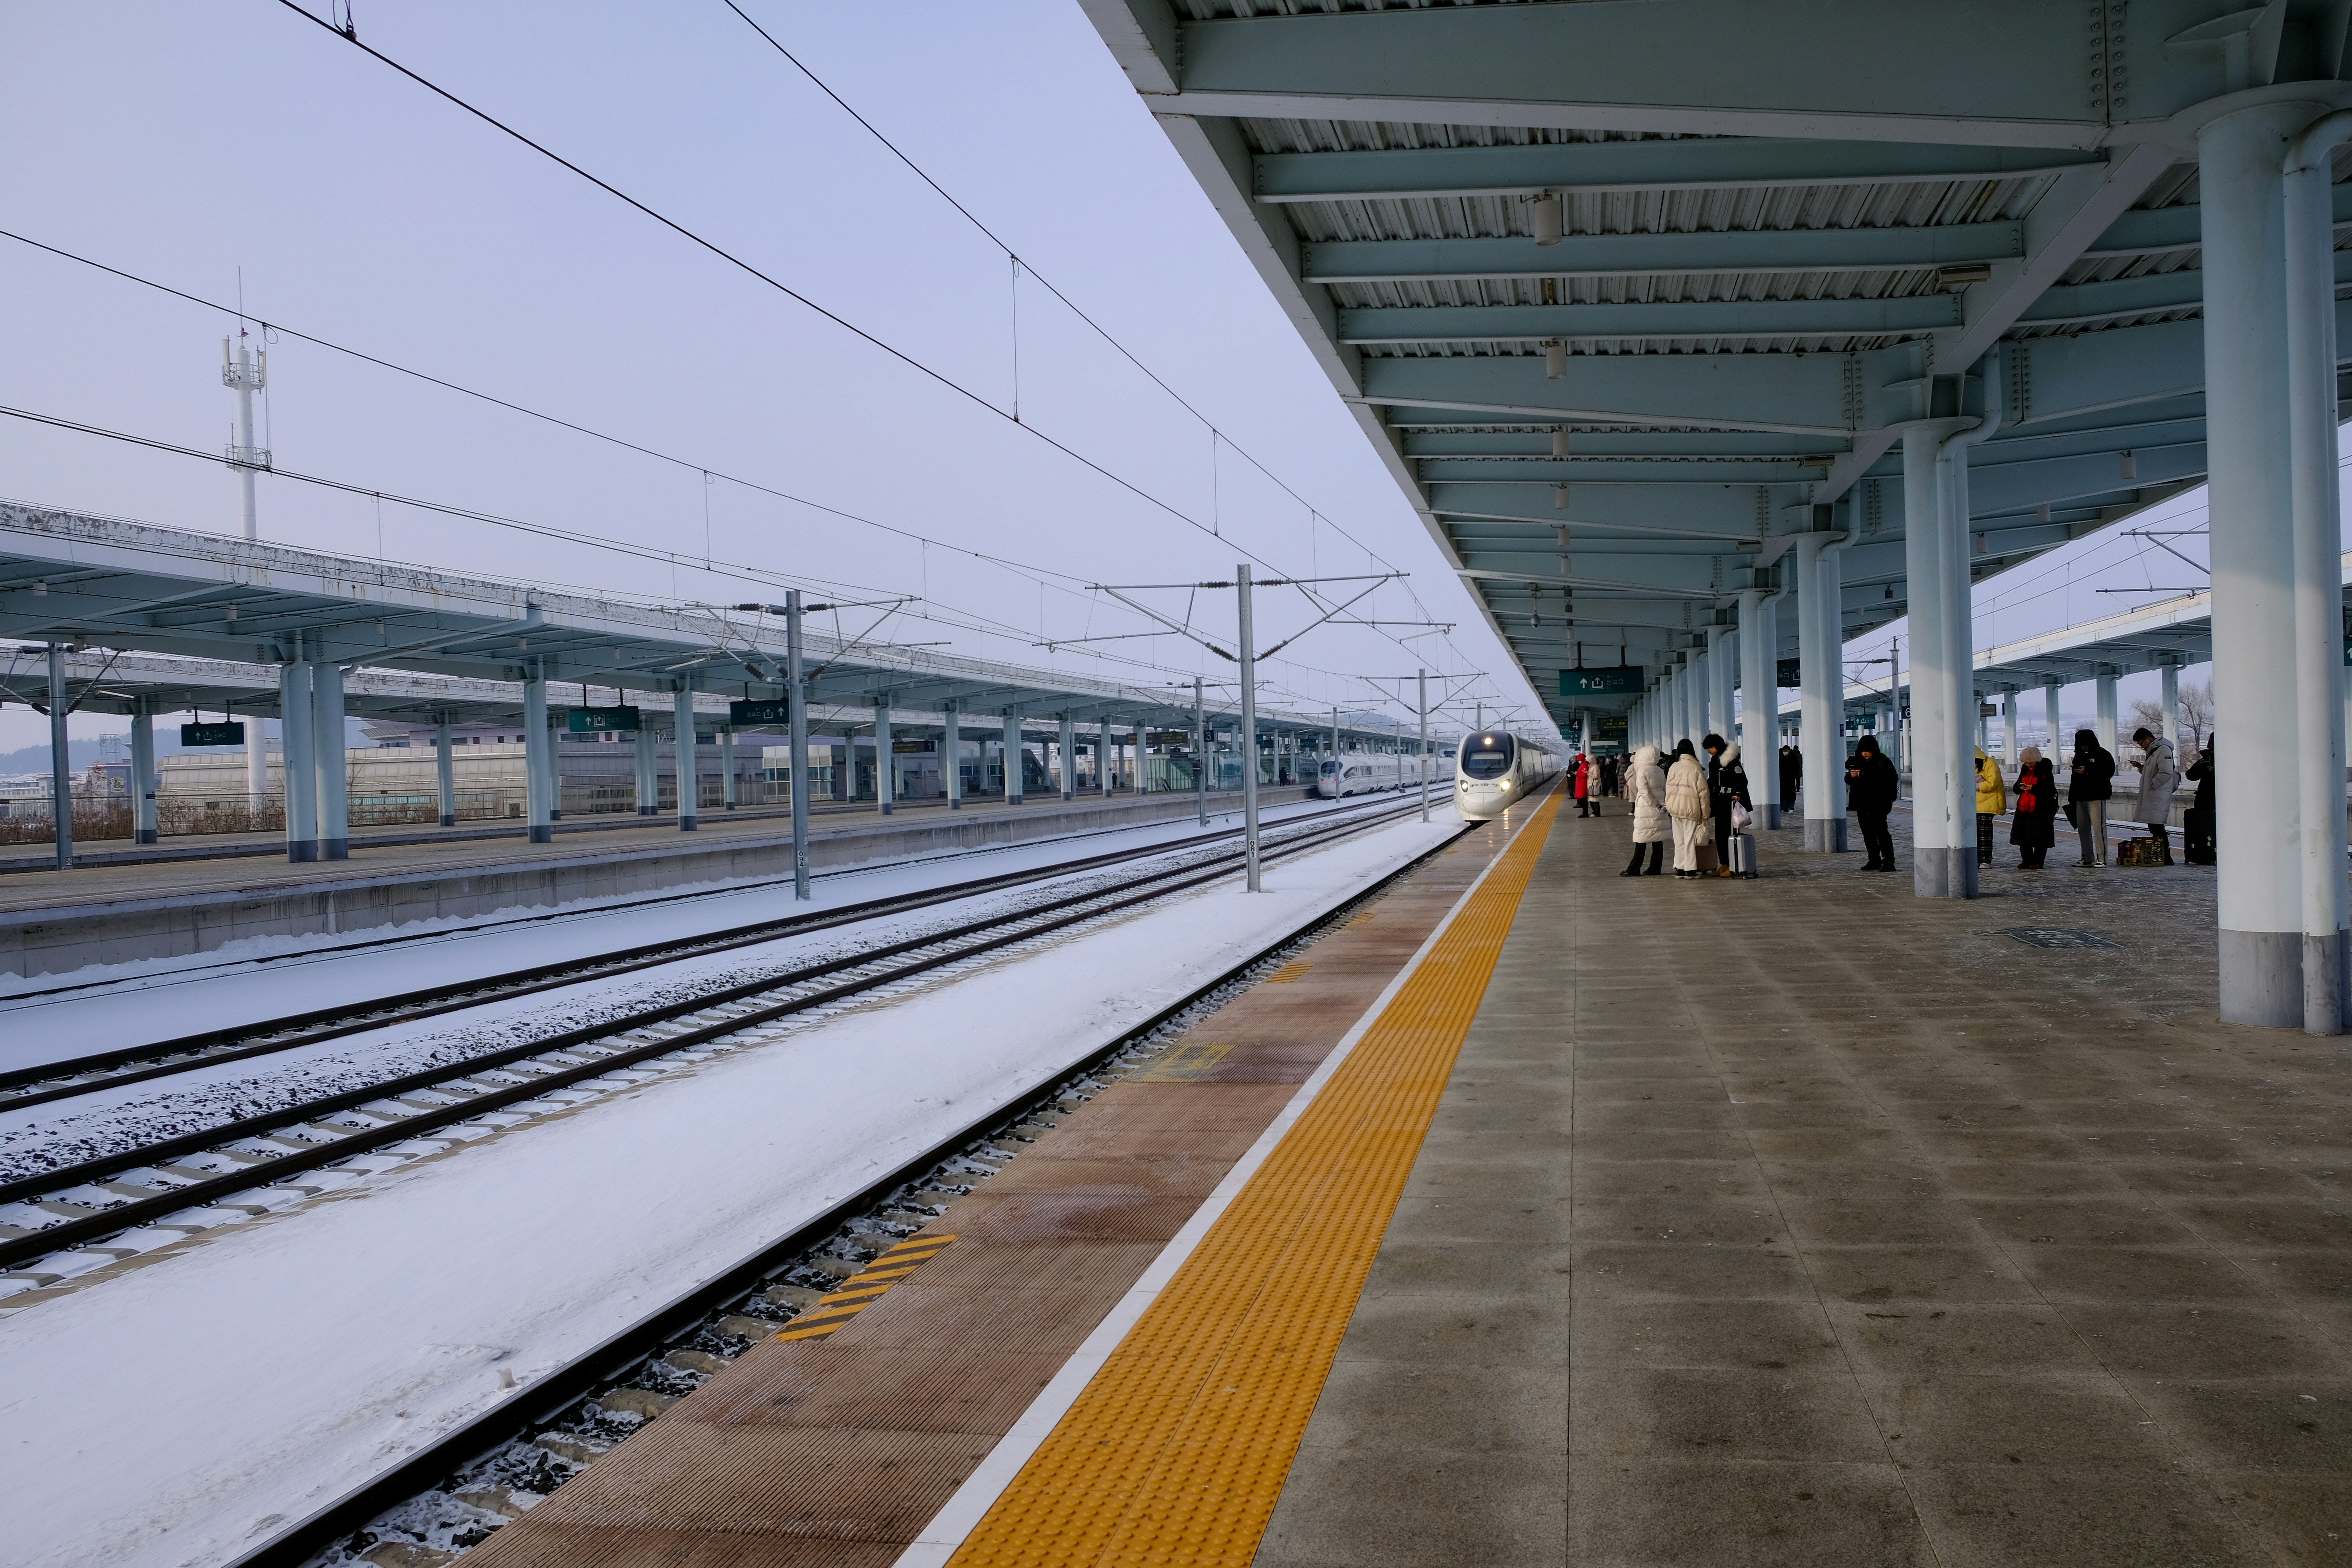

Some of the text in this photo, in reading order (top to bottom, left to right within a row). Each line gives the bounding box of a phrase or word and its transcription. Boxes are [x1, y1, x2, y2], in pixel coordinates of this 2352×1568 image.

[1905, 708, 1911, 717] 6
[1572, 720, 1579, 730] 4
[1206, 732, 1211, 740] 3
[928, 742, 931, 751] 1
